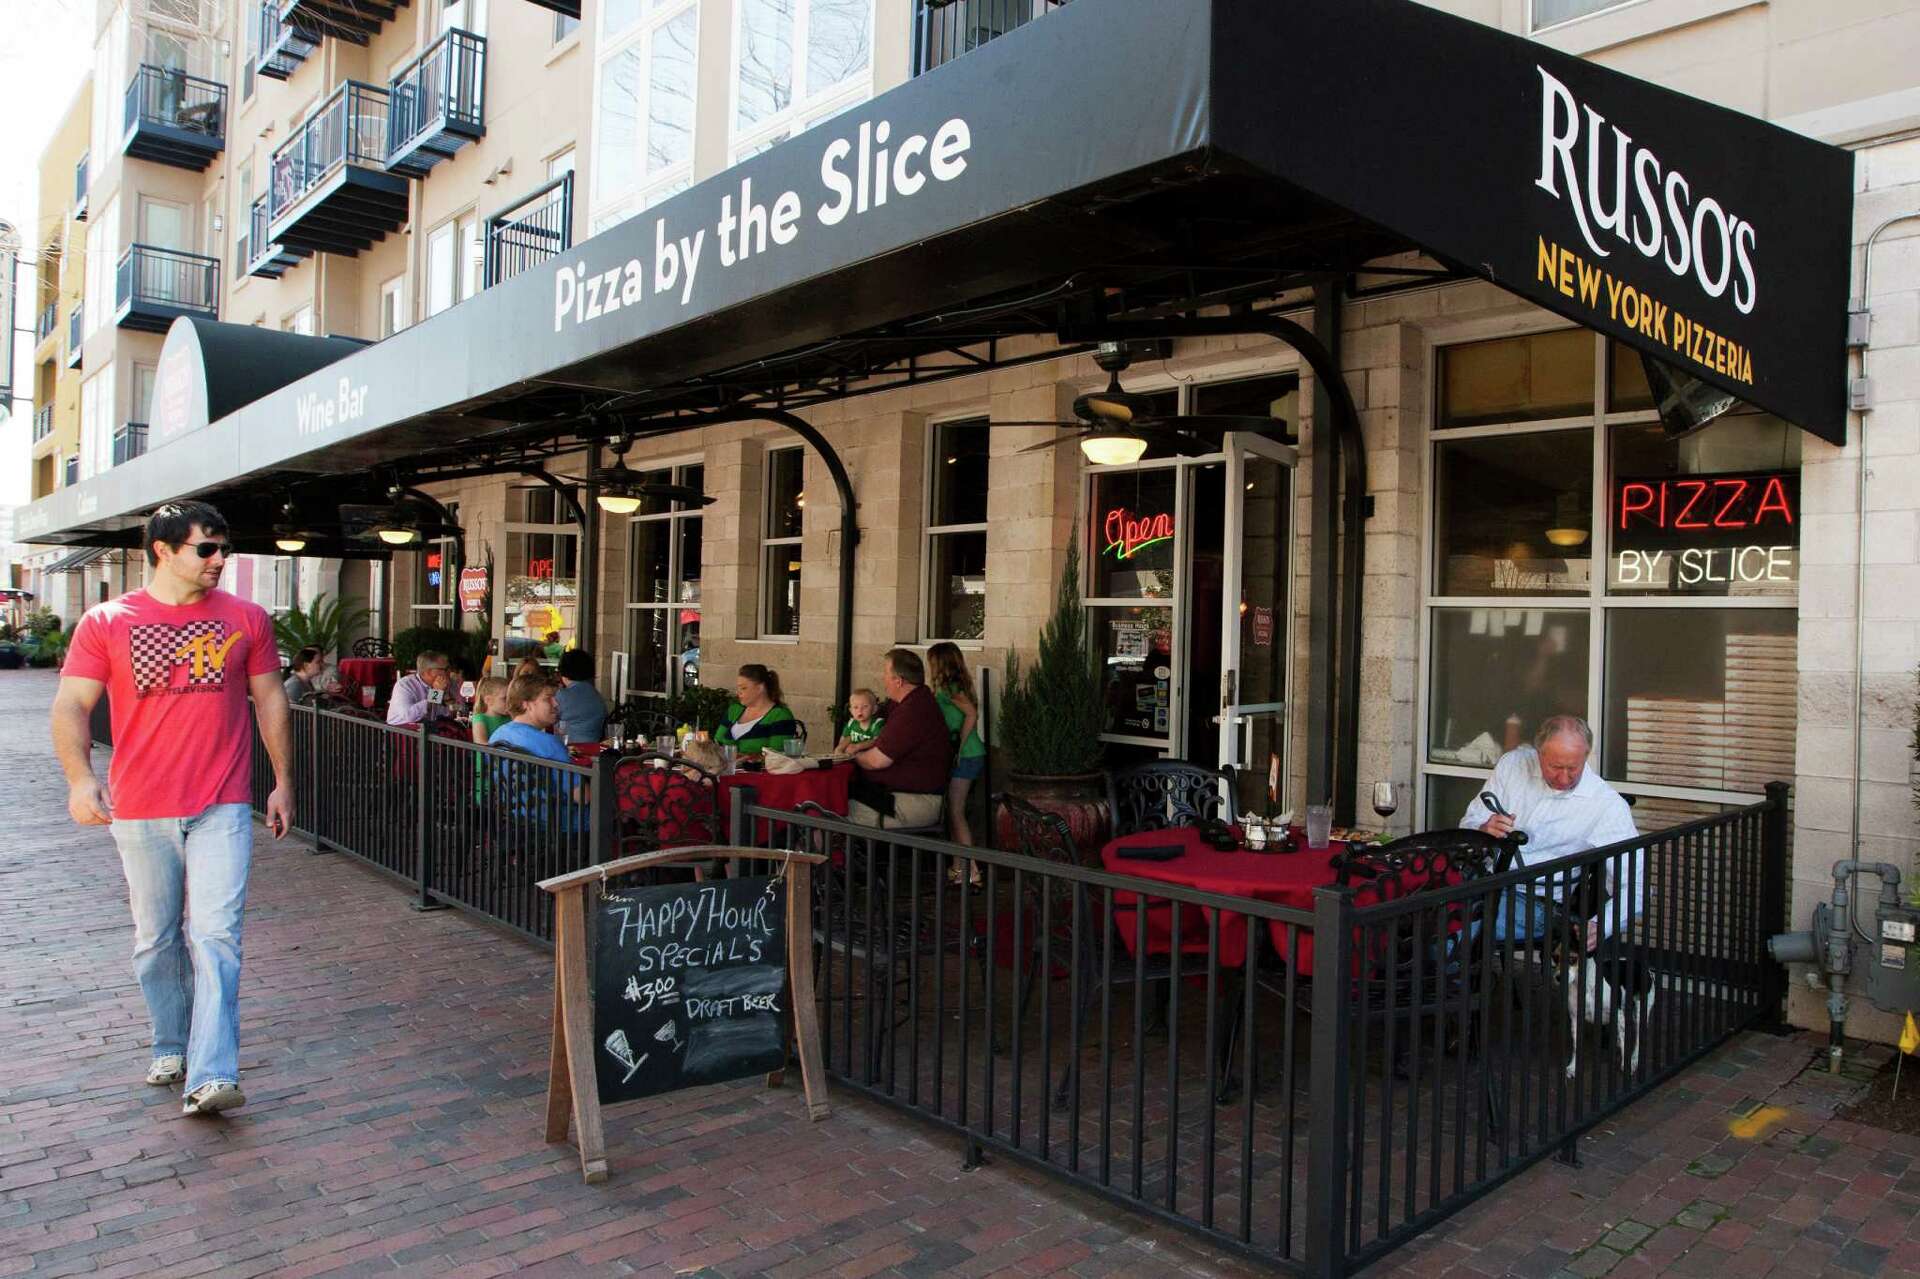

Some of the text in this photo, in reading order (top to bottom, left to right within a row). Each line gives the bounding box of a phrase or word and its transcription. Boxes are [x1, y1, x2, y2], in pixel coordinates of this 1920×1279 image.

[1535, 64, 1756, 315] RUSSO'S
[554, 117, 972, 332] Pizza by the Slice
[1536, 234, 1754, 386] NEW YORK PIZZERIA
[296, 377, 369, 438] Wine Bar
[1620, 477, 1793, 529] PIZZA
[1105, 507, 1174, 558] Open
[1617, 545, 1793, 584] BY SLICE
[129, 619, 243, 693] MTV
[432, 690, 439, 700] 2
[608, 896, 705, 947] HAPPY
[685, 993, 782, 1019] DRAFT BEER
